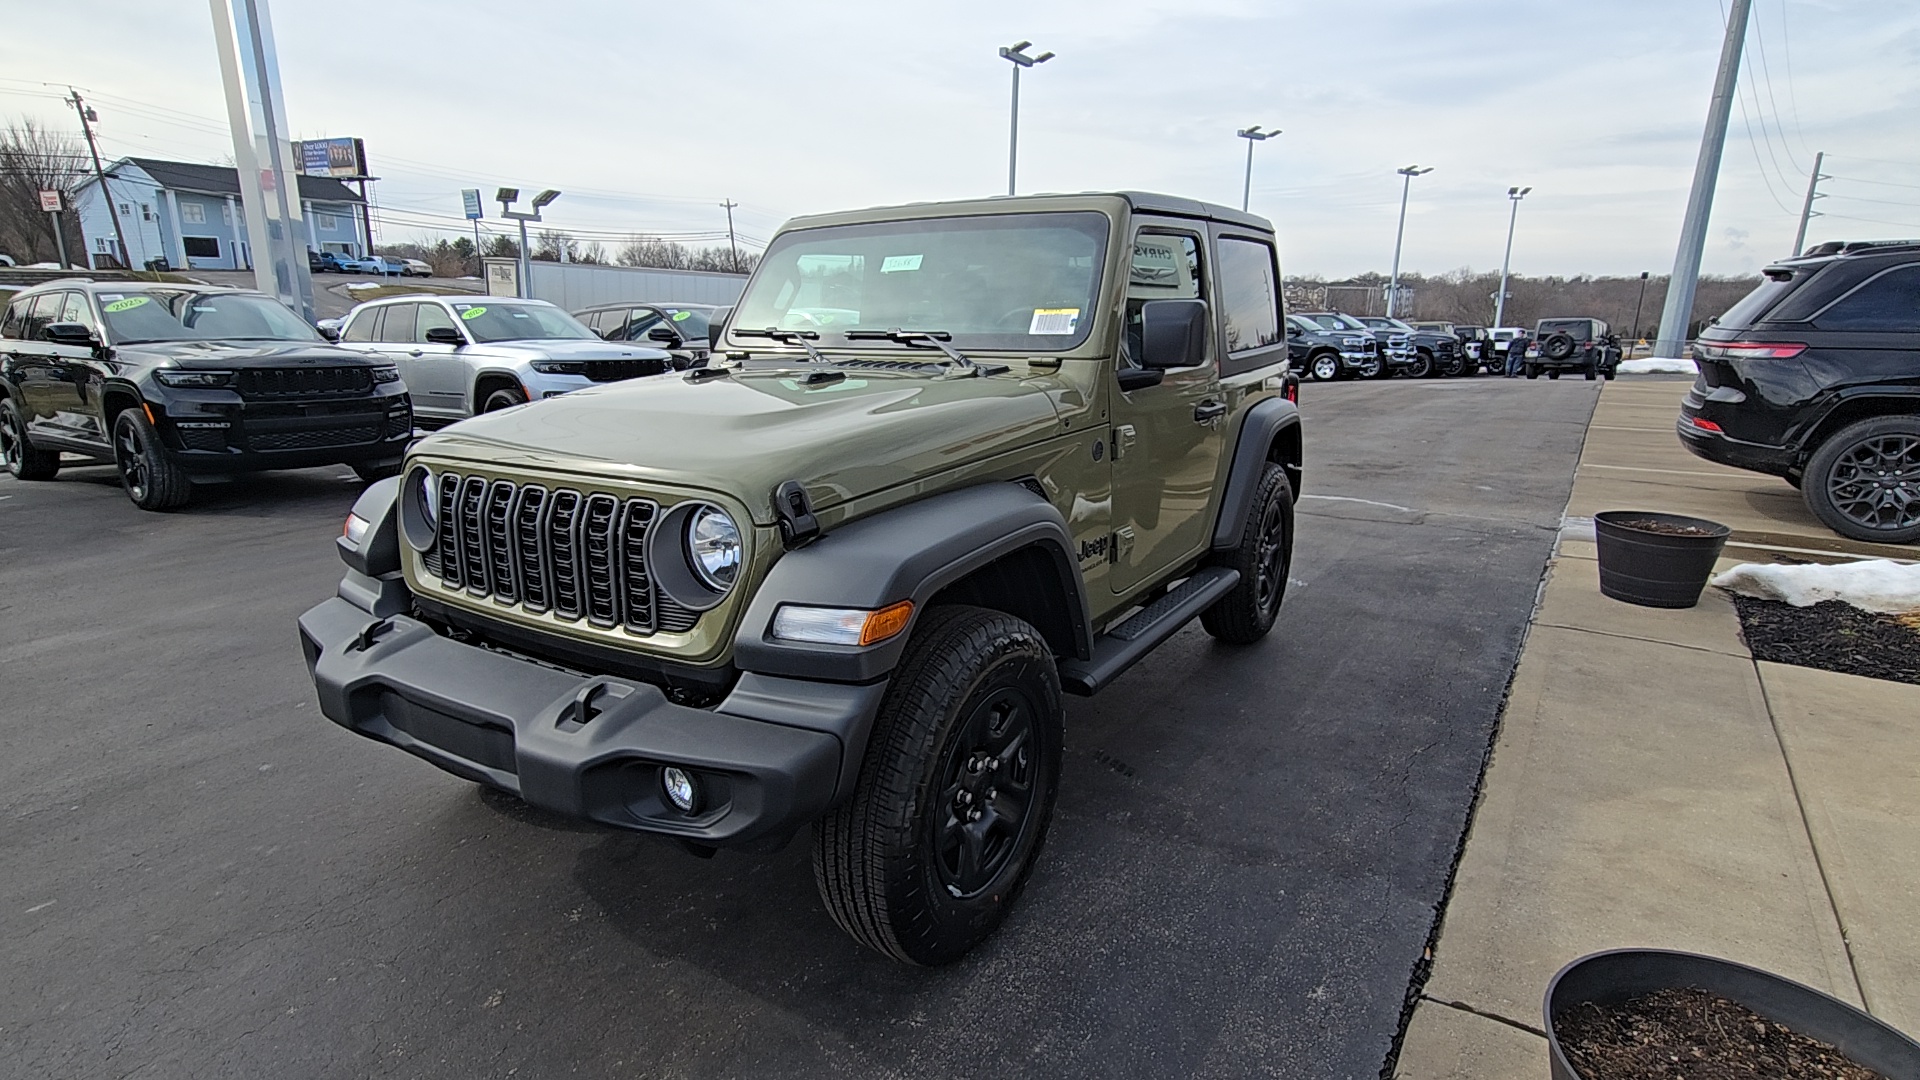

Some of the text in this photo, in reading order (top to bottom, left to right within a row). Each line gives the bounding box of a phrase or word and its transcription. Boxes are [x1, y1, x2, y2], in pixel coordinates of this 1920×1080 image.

[112, 298, 143, 311] 2025
[466, 308, 484, 318] 2025
[1076, 536, 1108, 562] Jeep
